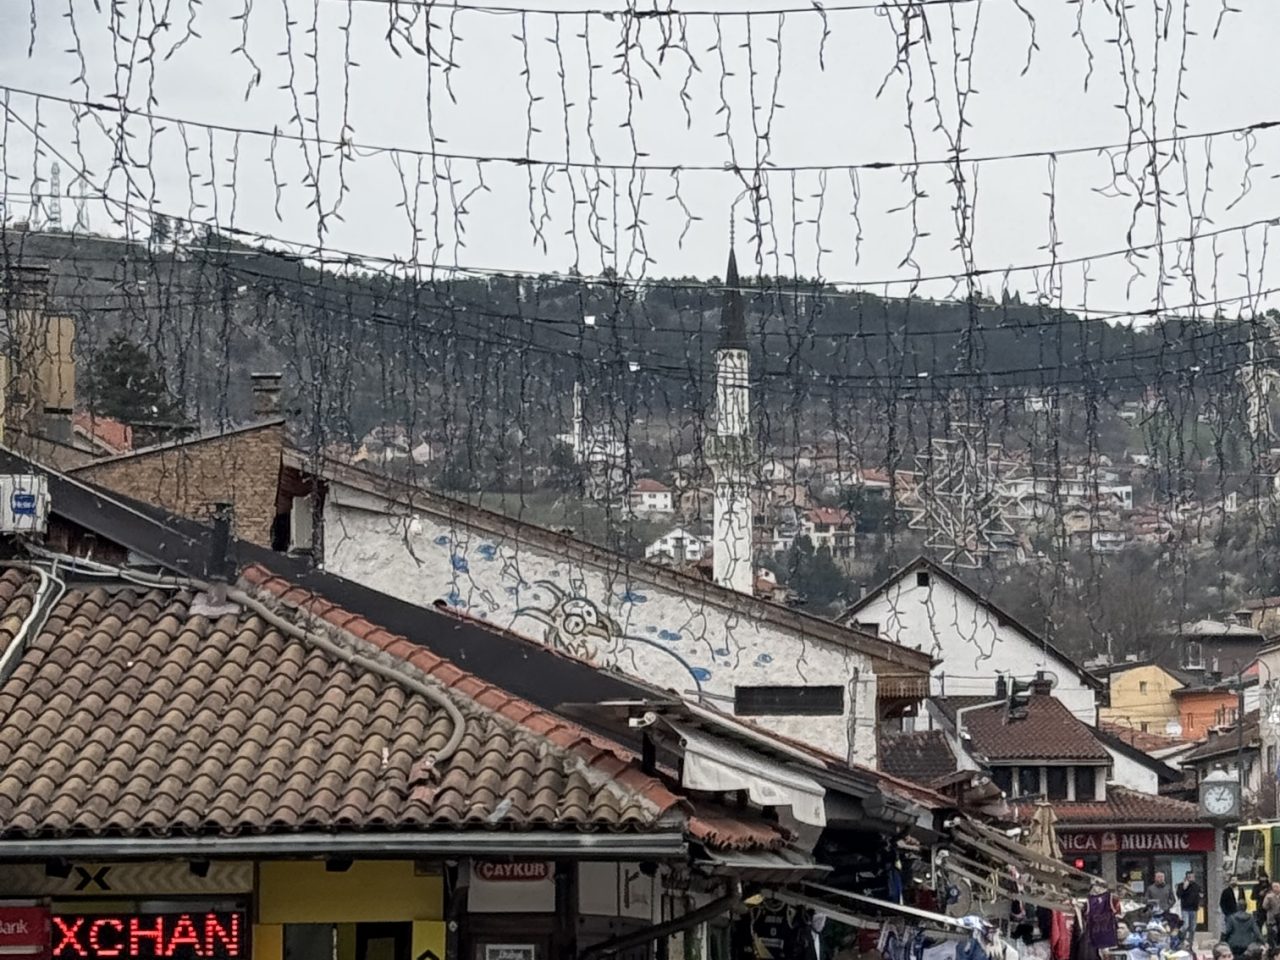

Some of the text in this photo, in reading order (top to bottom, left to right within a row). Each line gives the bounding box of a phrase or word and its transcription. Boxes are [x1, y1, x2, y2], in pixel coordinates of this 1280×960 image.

[1057, 834, 1097, 849] NICA
[0, 919, 29, 935] ank
[53, 913, 239, 957] XCHAN
